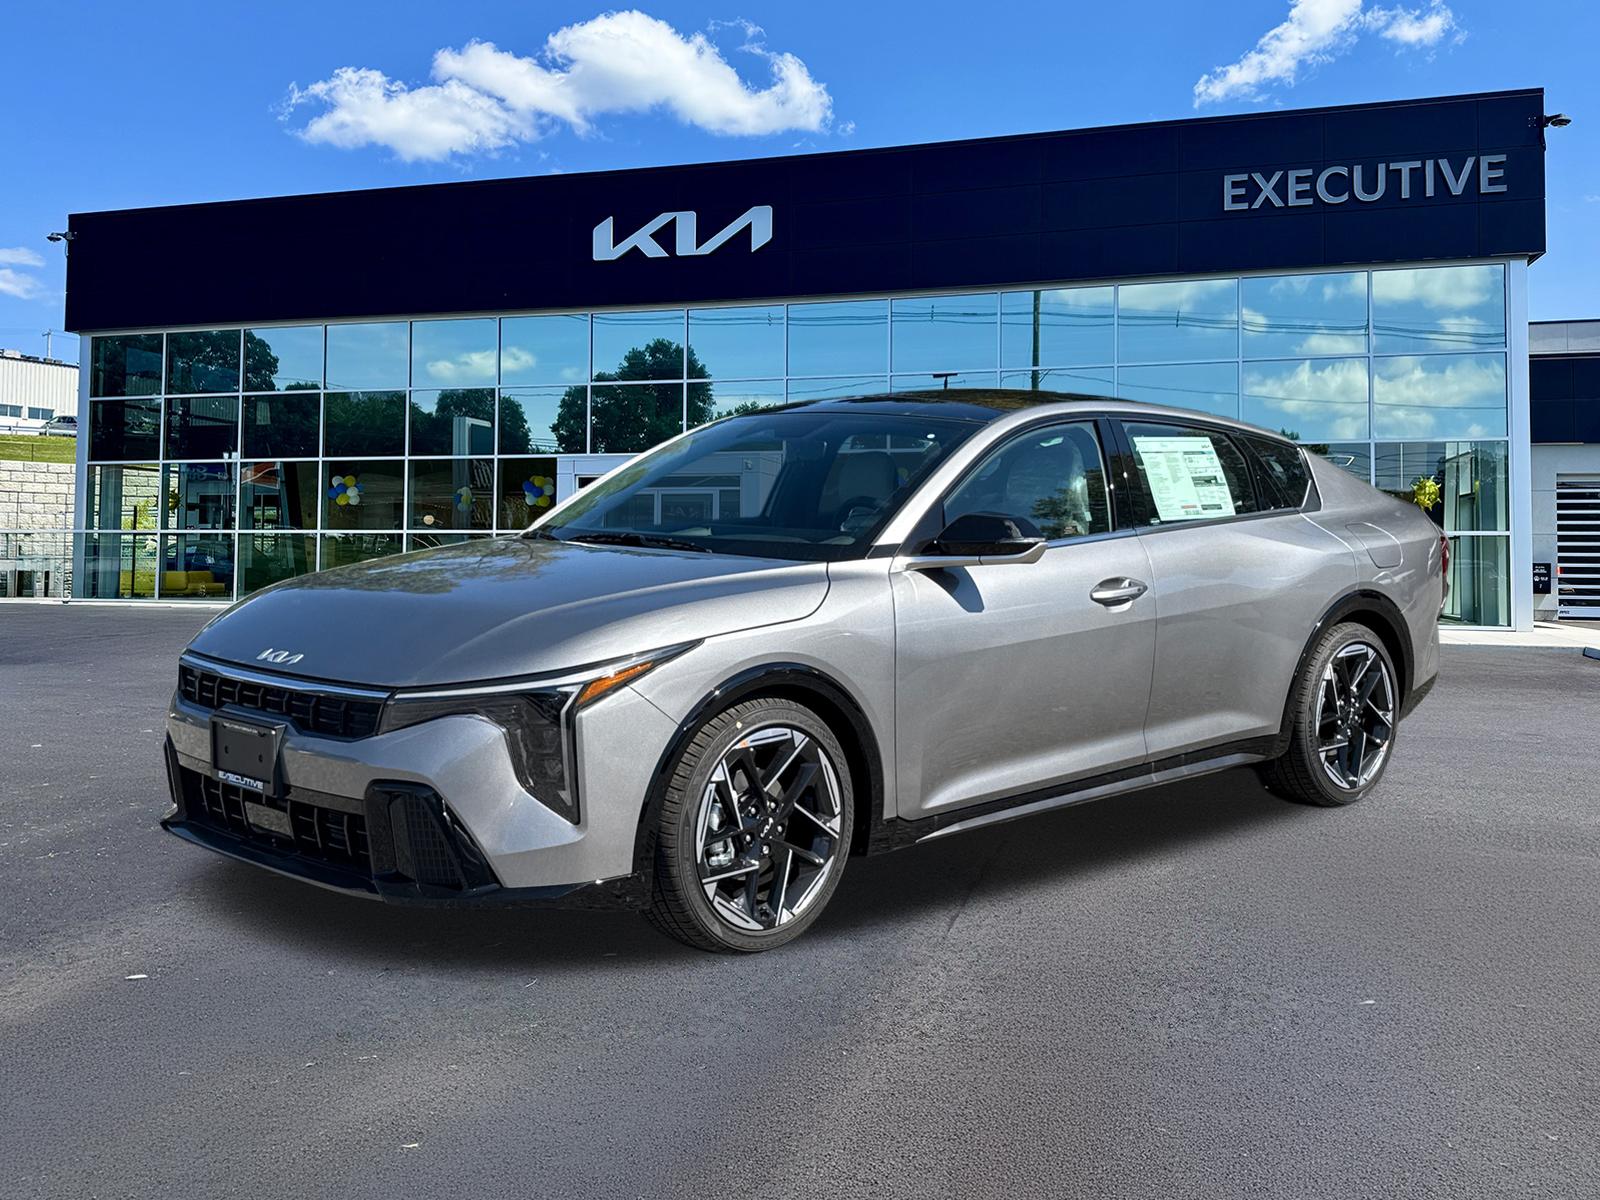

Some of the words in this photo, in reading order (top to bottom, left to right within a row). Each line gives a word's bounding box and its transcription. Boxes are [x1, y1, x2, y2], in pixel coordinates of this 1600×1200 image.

[1223, 154, 1508, 211] EXECUTIVE
[592, 205, 773, 262] KIA
[256, 648, 304, 665] KIA
[218, 770, 264, 790] EXECUTIVE
